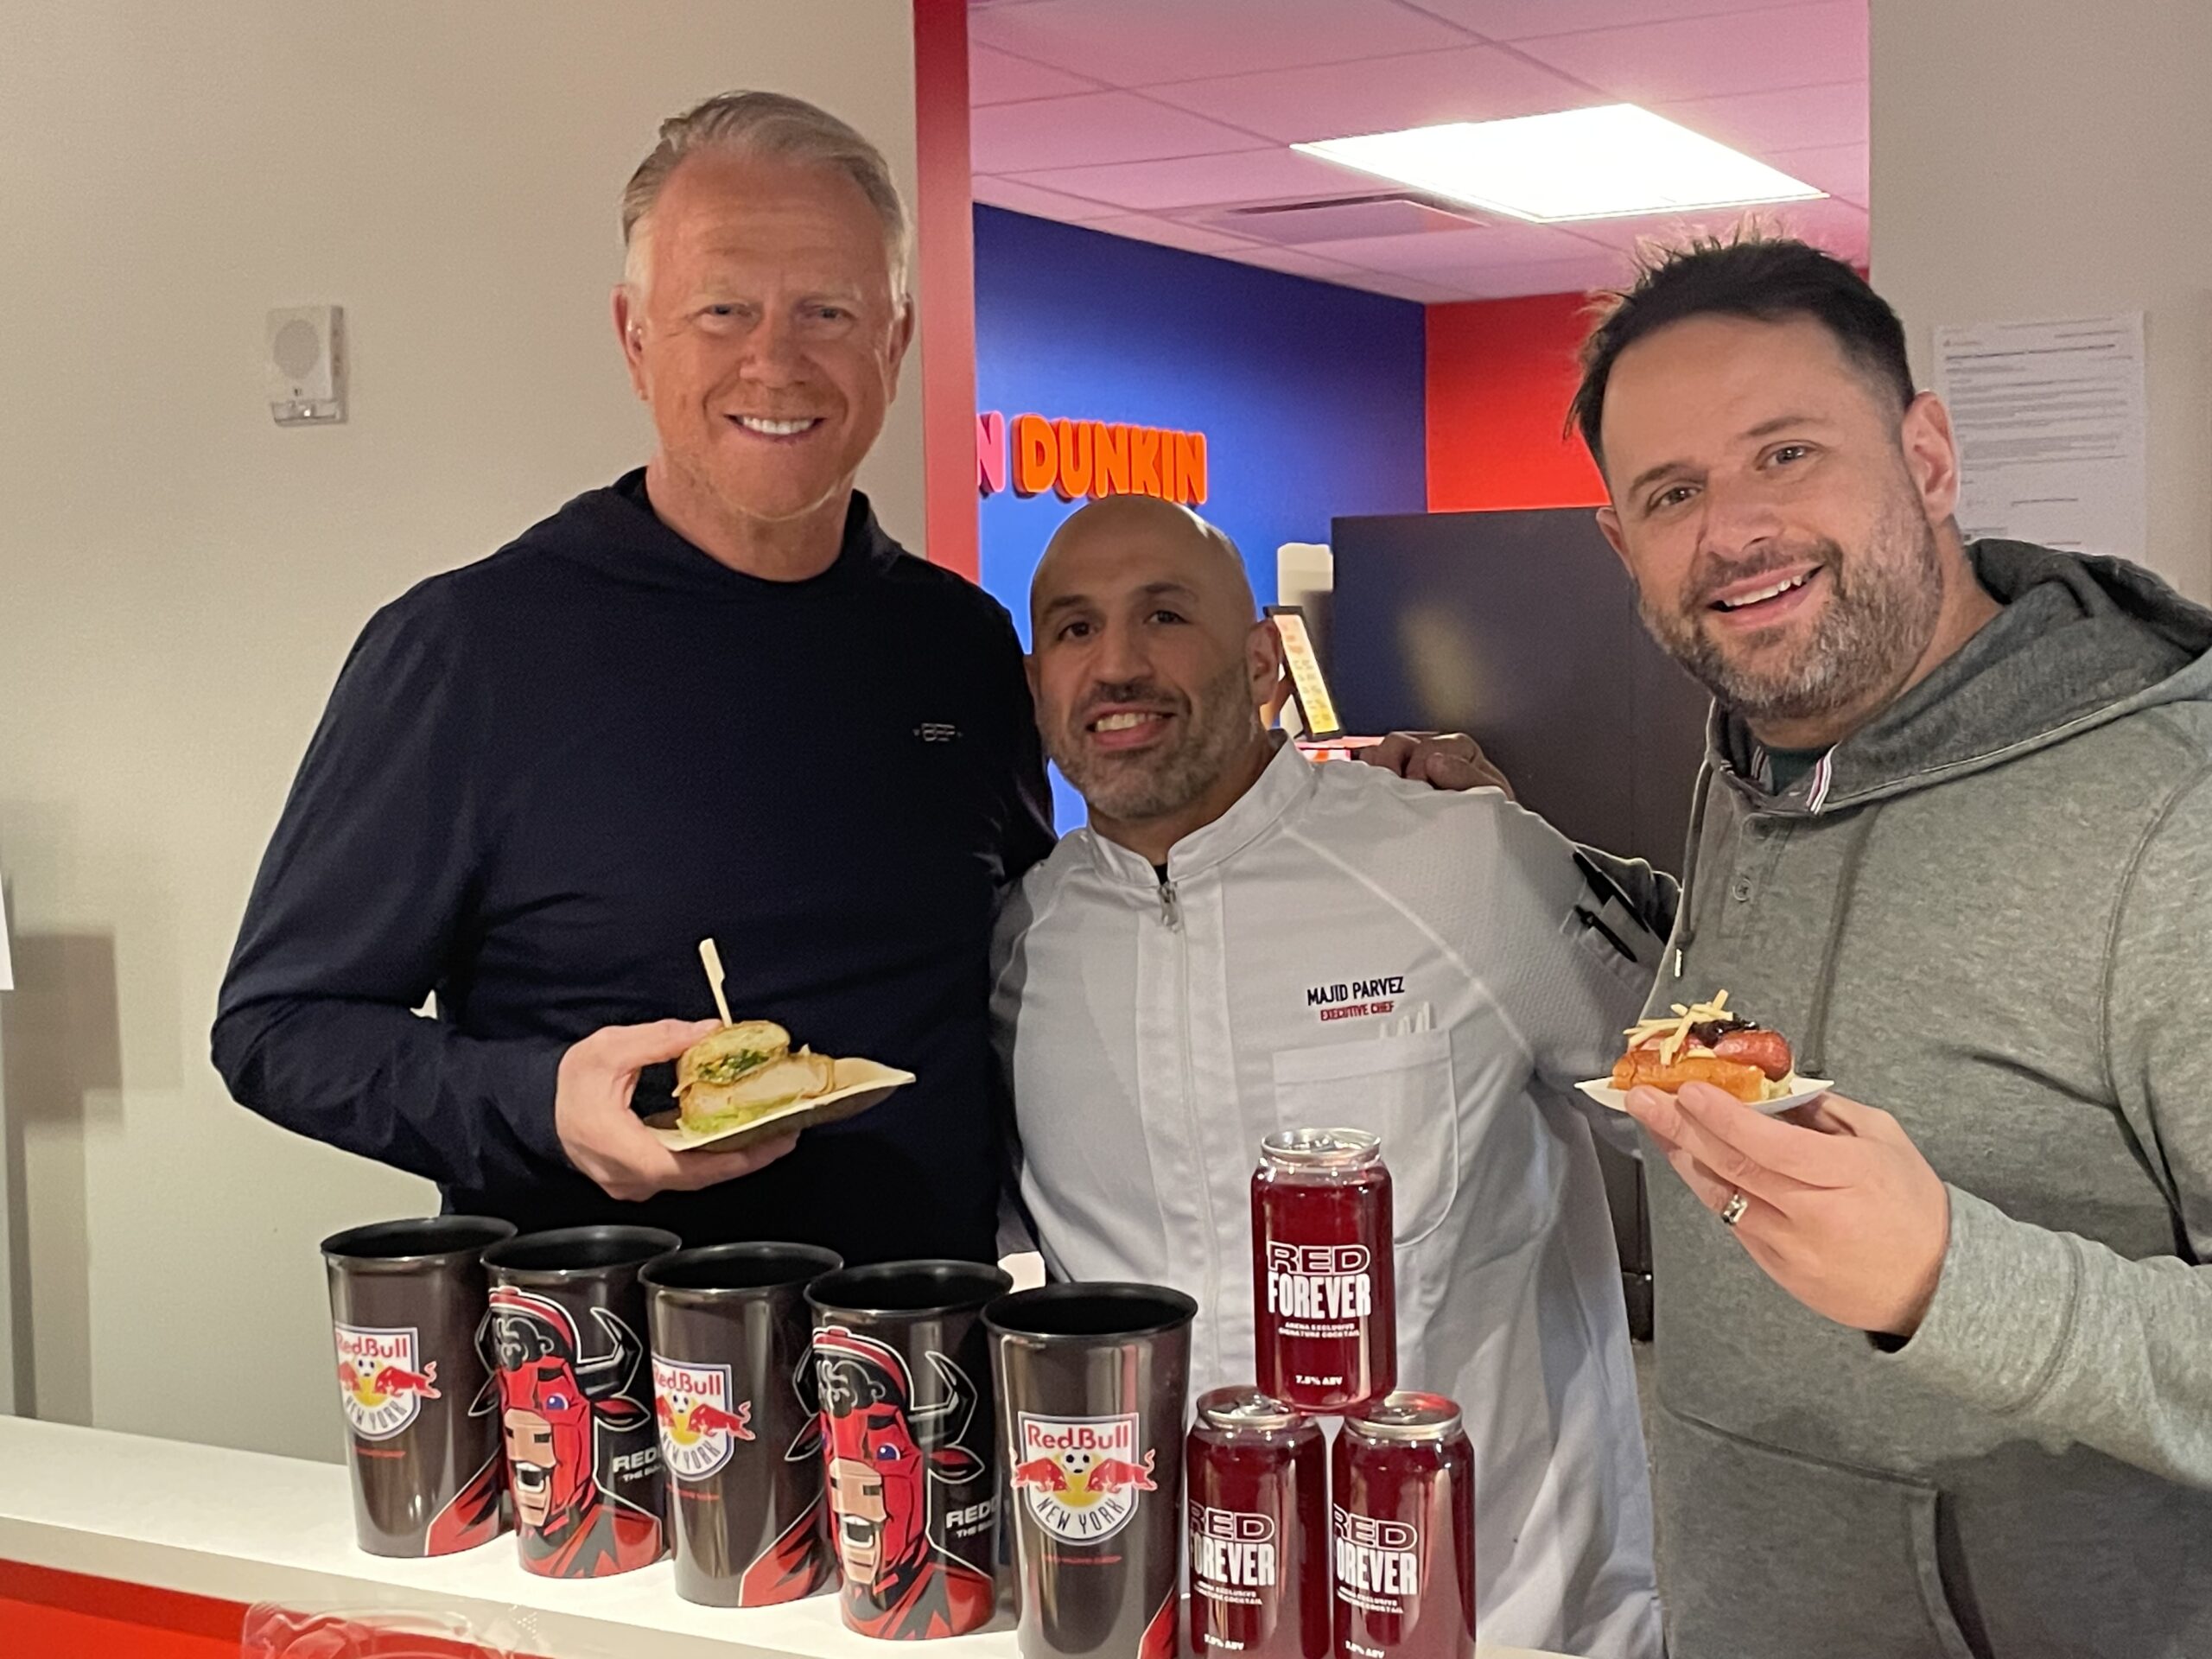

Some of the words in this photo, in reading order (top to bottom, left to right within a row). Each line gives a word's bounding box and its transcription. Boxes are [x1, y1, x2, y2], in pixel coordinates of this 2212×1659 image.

[1012, 414, 1207, 505] DUNKIN
[1307, 984, 1348, 1006] MAJID
[1352, 976, 1405, 1000] PARVEZ
[1320, 1004, 1370, 1021] EXECUTIVE
[1370, 1001, 1394, 1014] CHEF
[1267, 1241, 1370, 1275] RED
[1268, 1271, 1371, 1319] FOREVER
[366, 1338, 407, 1357] Bull
[680, 1372, 721, 1395] Bull
[368, 1400, 408, 1430] YORK
[1027, 1424, 1072, 1449] Red
[1079, 1425, 1128, 1449] Bull
[613, 1446, 662, 1473] RED
[683, 1440, 721, 1470] YORK
[1037, 1497, 1071, 1531] NEW
[1078, 1497, 1125, 1535] YORK
[1333, 1503, 1418, 1552] RED
[1336, 1537, 1418, 1595] OREVER
